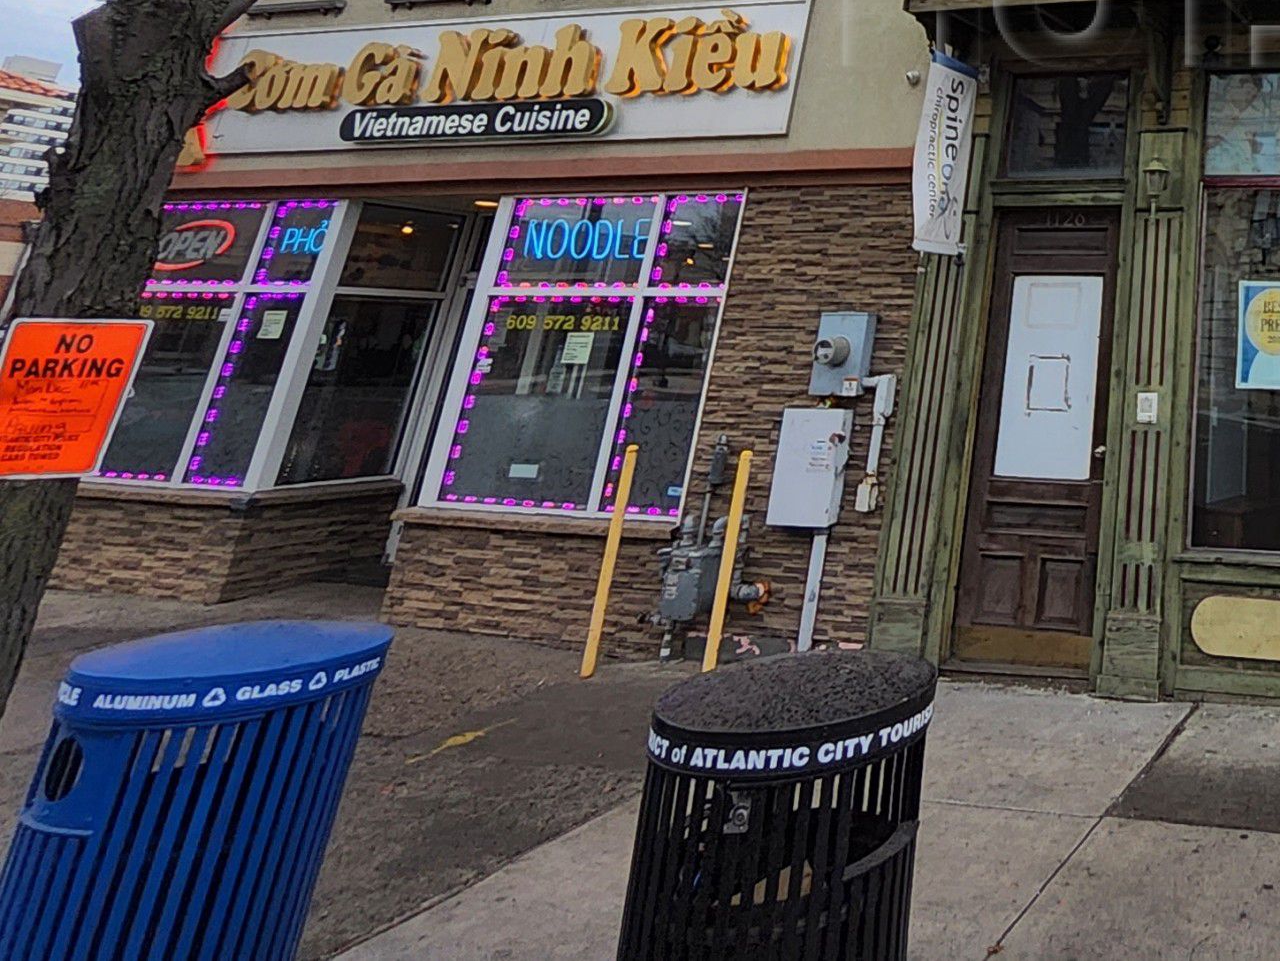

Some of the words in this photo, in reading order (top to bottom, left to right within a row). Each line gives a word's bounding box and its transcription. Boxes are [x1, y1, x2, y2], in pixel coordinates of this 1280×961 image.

[422, 23, 602, 102] Ninh
[604, 8, 791, 98] Kiều
[352, 111, 488, 139] Vietnamese
[494, 104, 591, 132] Cuisine
[927, 86, 943, 170] chiropractic
[944, 77, 964, 161] Spine
[926, 173, 937, 218] center
[158, 229, 226, 260] OPEN
[186, 306, 219, 319] 9211
[506, 316, 536, 330] 609
[543, 315, 575, 330] 572
[580, 315, 620, 331] 9211
[54, 333, 94, 354] NO
[8, 358, 125, 379] PARKING
[92, 693, 196, 711] ALUMINUM
[236, 679, 303, 701] GLASS
[333, 657, 381, 684] PLASTIC
[671, 744, 687, 765] of
[690, 746, 810, 770] ATLANTIC
[817, 733, 874, 765] CITY
